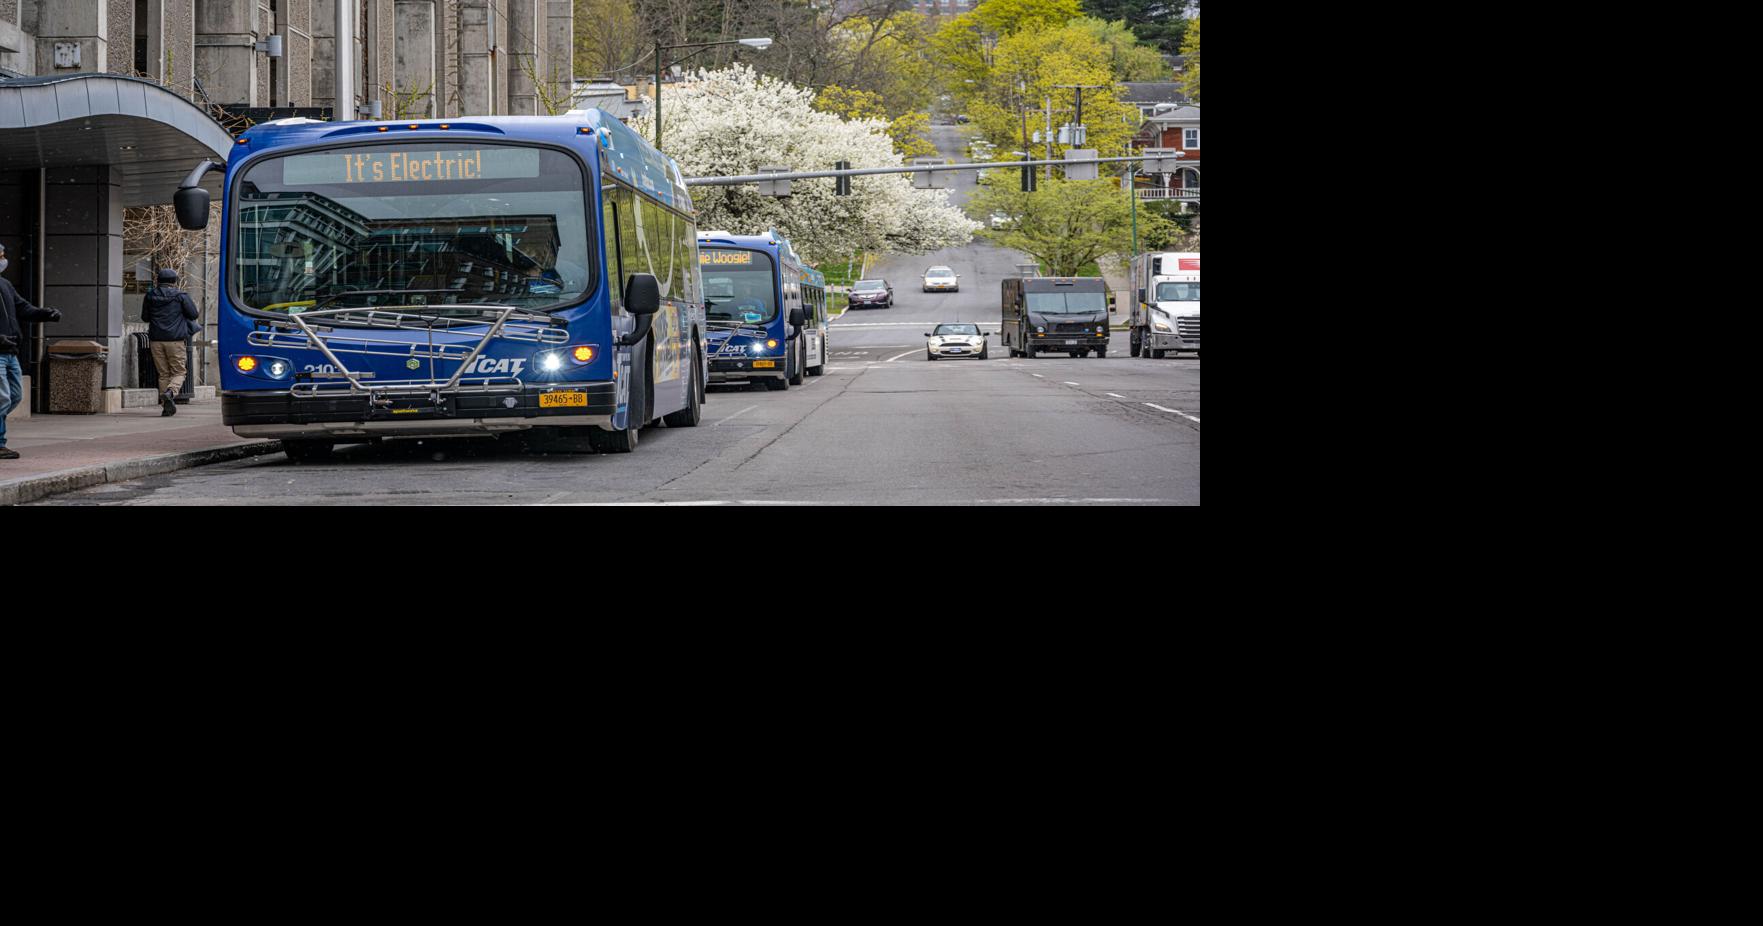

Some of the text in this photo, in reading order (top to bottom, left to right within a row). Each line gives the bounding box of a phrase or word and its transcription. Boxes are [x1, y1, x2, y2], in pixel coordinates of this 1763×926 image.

[344, 150, 481, 182] It's Electric!
[712, 251, 750, 264] Woogie!
